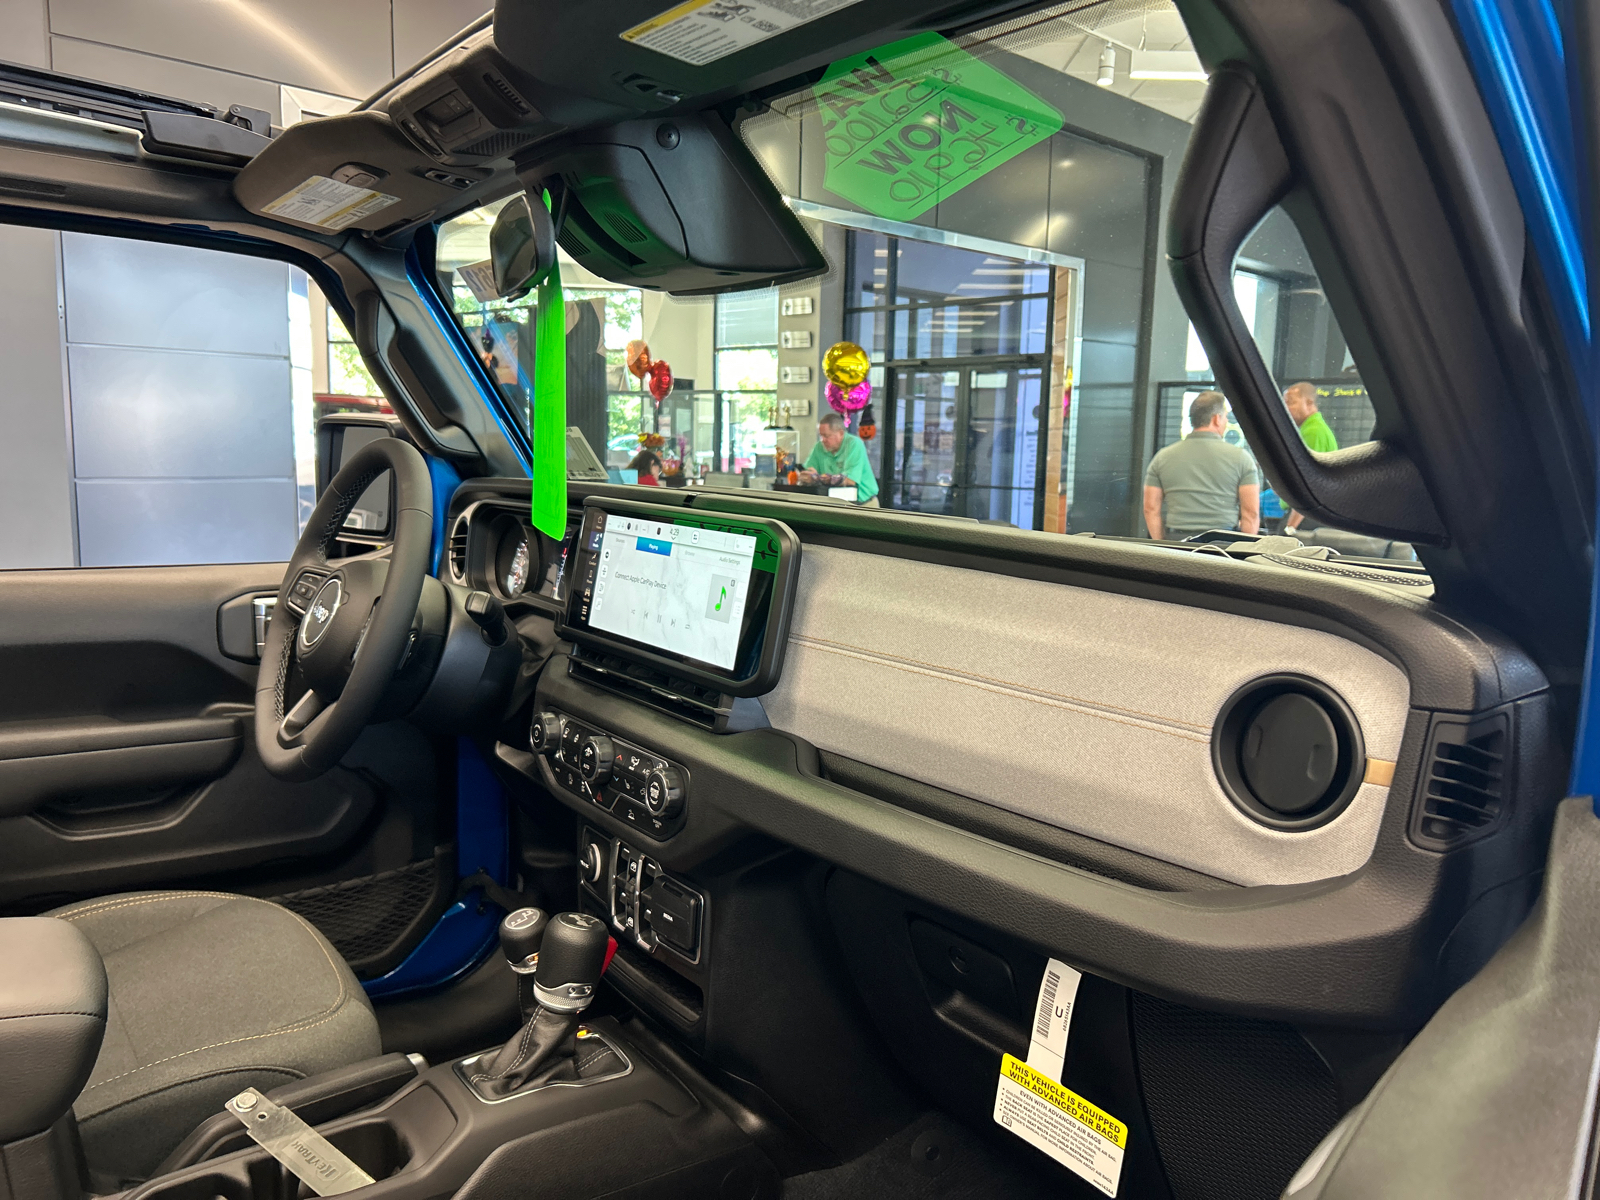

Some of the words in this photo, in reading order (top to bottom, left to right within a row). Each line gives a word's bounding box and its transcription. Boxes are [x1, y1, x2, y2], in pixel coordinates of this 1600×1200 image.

[614, 571, 629, 580] Connect
[630, 574, 640, 584] Apple
[640, 577, 654, 588] CarPlay
[654, 580, 667, 590] Device
[1008, 1069, 1030, 1087] WITH
[1031, 1082, 1077, 1117] ADVANCED
[1078, 1112, 1094, 1127] AIR
[1095, 1122, 1119, 1143] BAGS
[1010, 1061, 1028, 1078] THIS
[1030, 1073, 1065, 1100] VEHICLE
[1067, 1095, 1075, 1106] IS
[1077, 1101, 1120, 1134] EQUIPPED
[1019, 1089, 1033, 1102] EVEN
[1033, 1098, 1047, 1110] WITH
[1047, 1107, 1076, 1129] ADVANCED
[1076, 1125, 1086, 1135] AIR
[1086, 1131, 1101, 1145] BAGS
